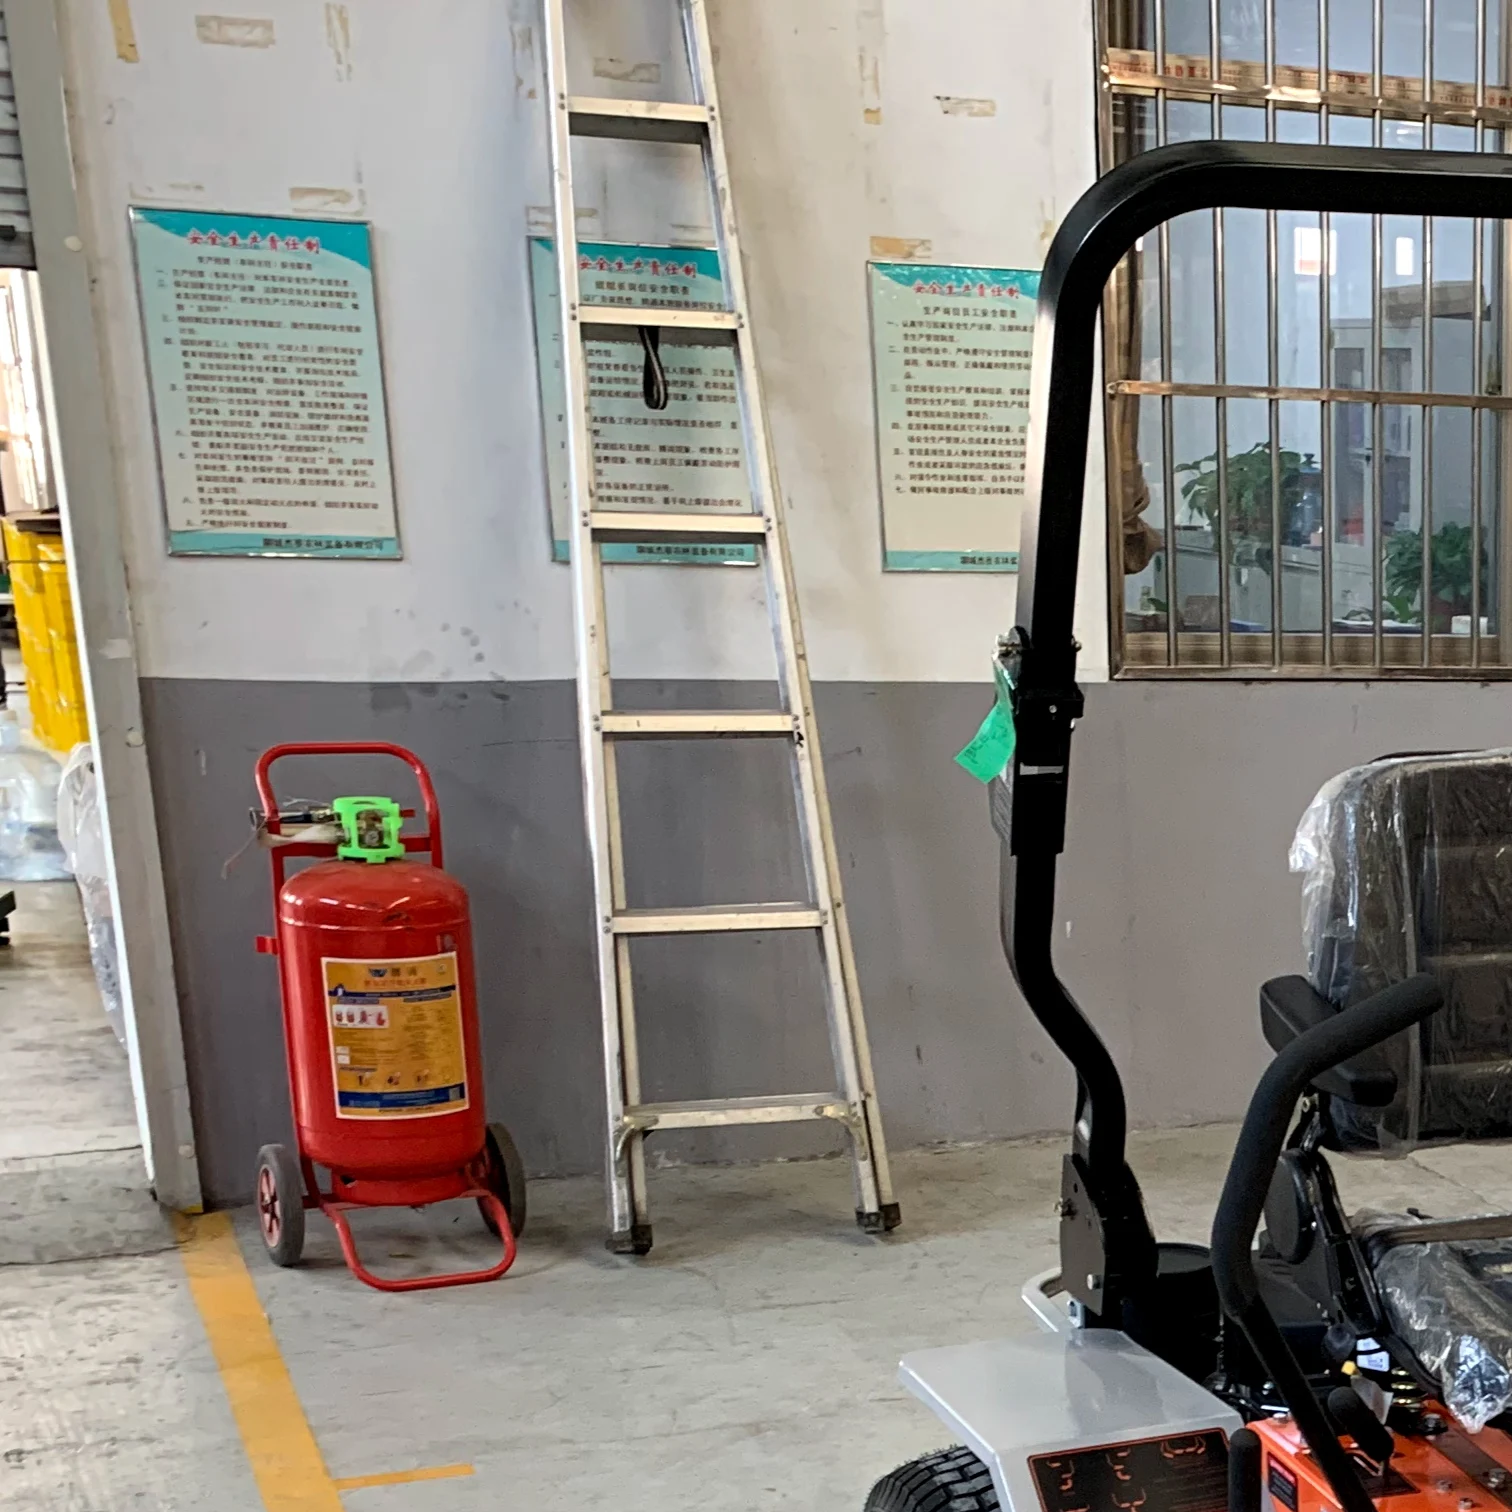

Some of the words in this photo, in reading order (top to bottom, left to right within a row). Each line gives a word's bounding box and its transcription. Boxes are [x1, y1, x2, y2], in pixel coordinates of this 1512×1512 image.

[187, 229, 320, 254] 安全生产责任制
[579, 257, 697, 278] 安全生产责任制
[912, 281, 1020, 299] 安全生产责任制
